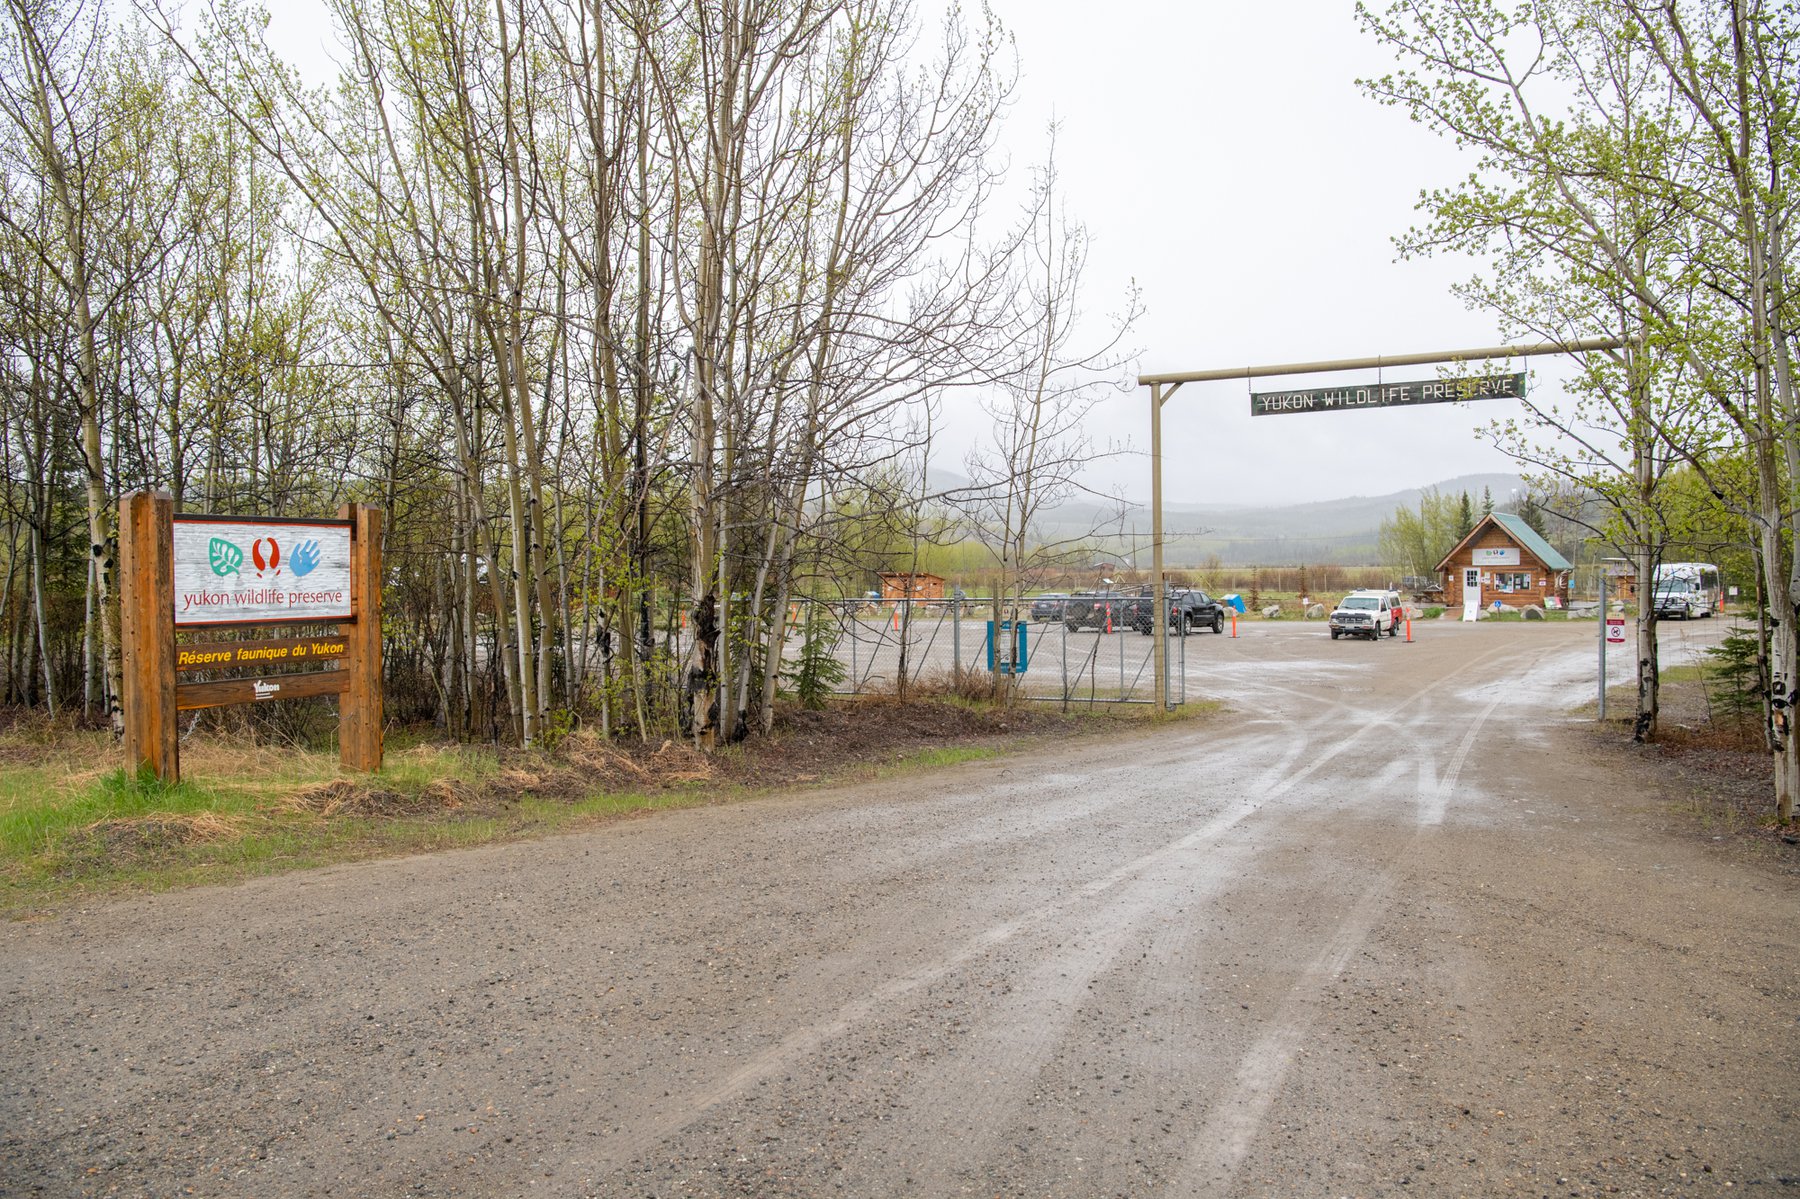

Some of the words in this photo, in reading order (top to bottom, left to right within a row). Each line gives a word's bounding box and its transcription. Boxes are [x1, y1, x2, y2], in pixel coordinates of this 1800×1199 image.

[1262, 393, 1313, 411] YUKON
[1325, 386, 1410, 406] WILDLIFE
[184, 589, 230, 610] yukon
[234, 588, 284, 605] wildlife
[289, 590, 342, 607] preserve
[178, 651, 231, 665] Réserve
[237, 646, 287, 661] faunique
[292, 643, 307, 656] du
[311, 641, 343, 655] Yukon
[253, 679, 280, 693] Yukon
